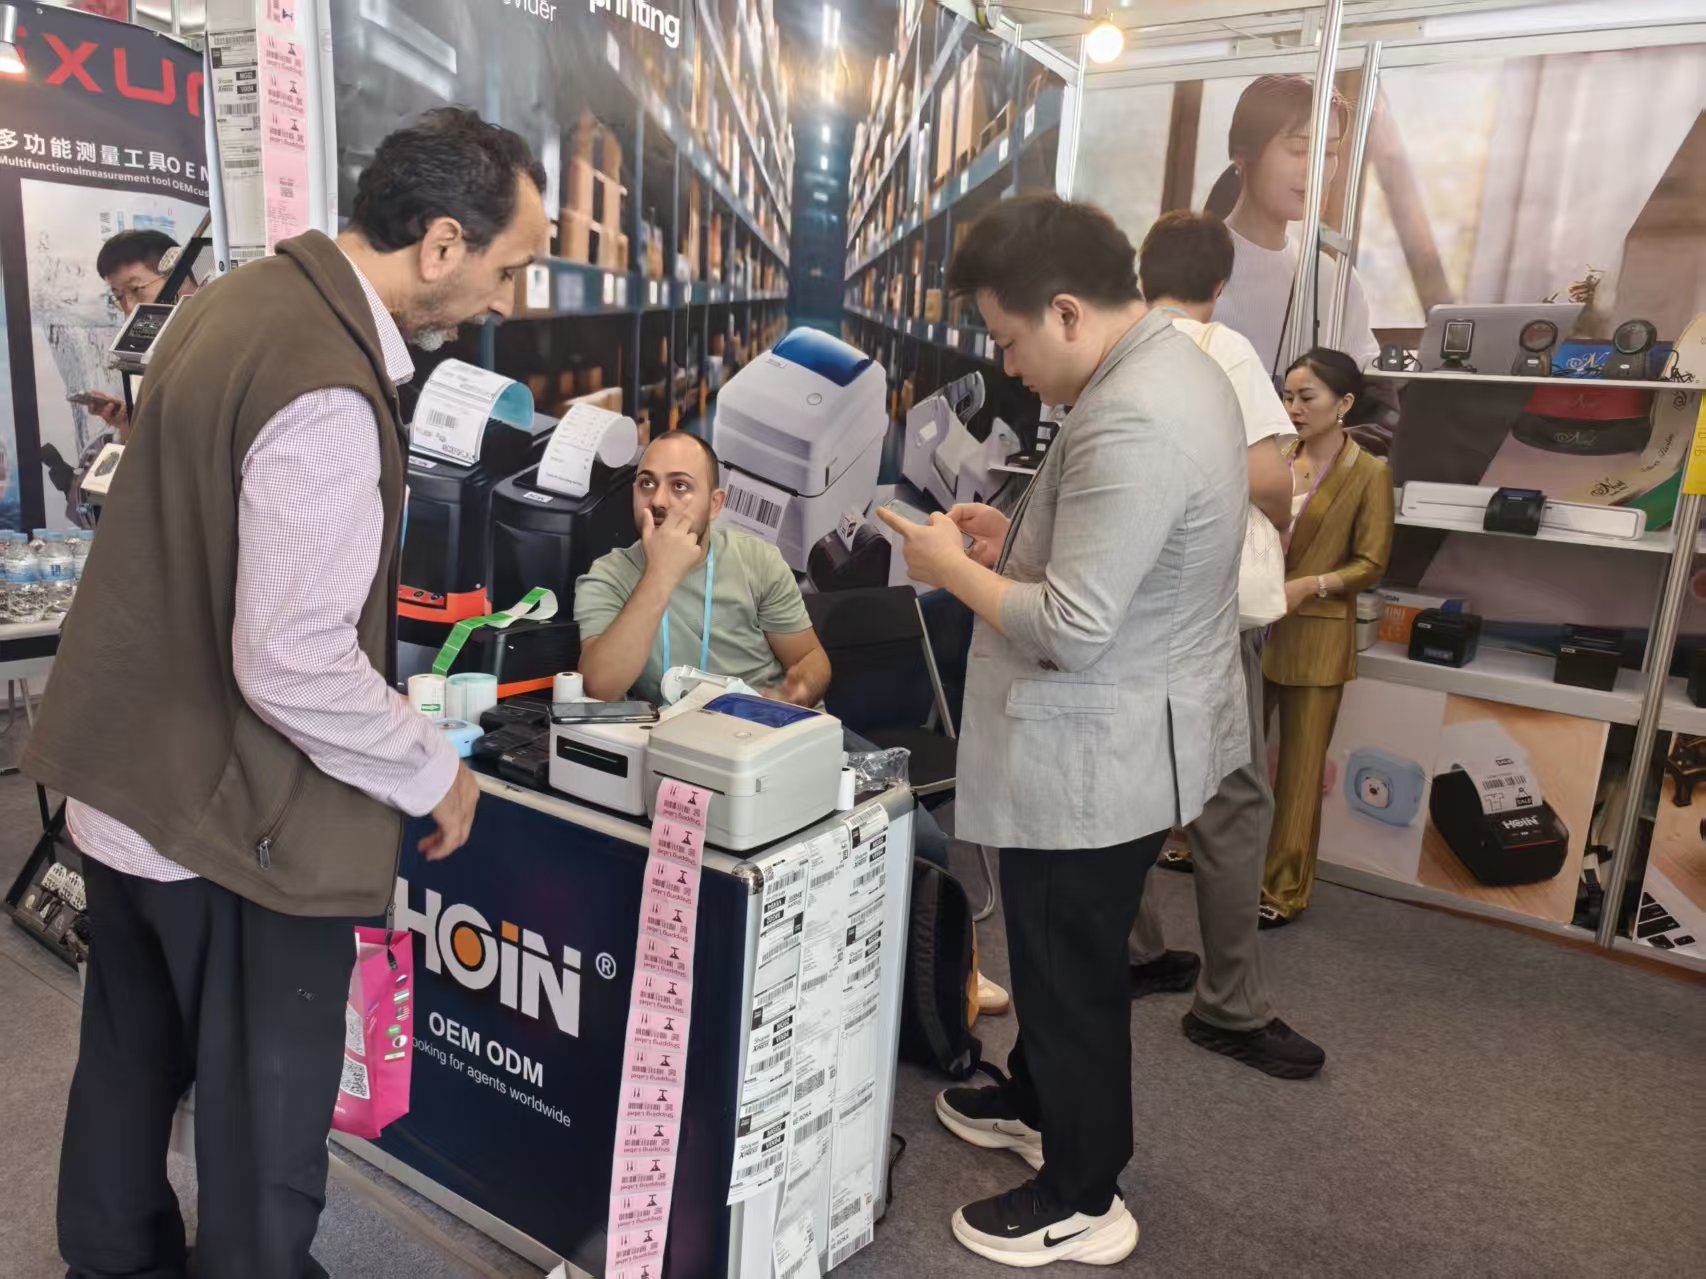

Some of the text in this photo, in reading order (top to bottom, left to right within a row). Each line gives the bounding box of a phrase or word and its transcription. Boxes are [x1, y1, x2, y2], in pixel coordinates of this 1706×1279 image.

[152, 176, 171, 188] tool
[634, 1035, 681, 1050] Shipping Label
[428, 1011, 481, 1057] OEM
[486, 1040, 544, 1088] ODM
[449, 1052, 465, 1073] for
[467, 1062, 507, 1095] agents
[509, 1086, 571, 1128] worldwide
[626, 1109, 674, 1118] Shipping Label
[623, 1145, 670, 1154] Shipping Label
[619, 1180, 666, 1192] Shipping Label
